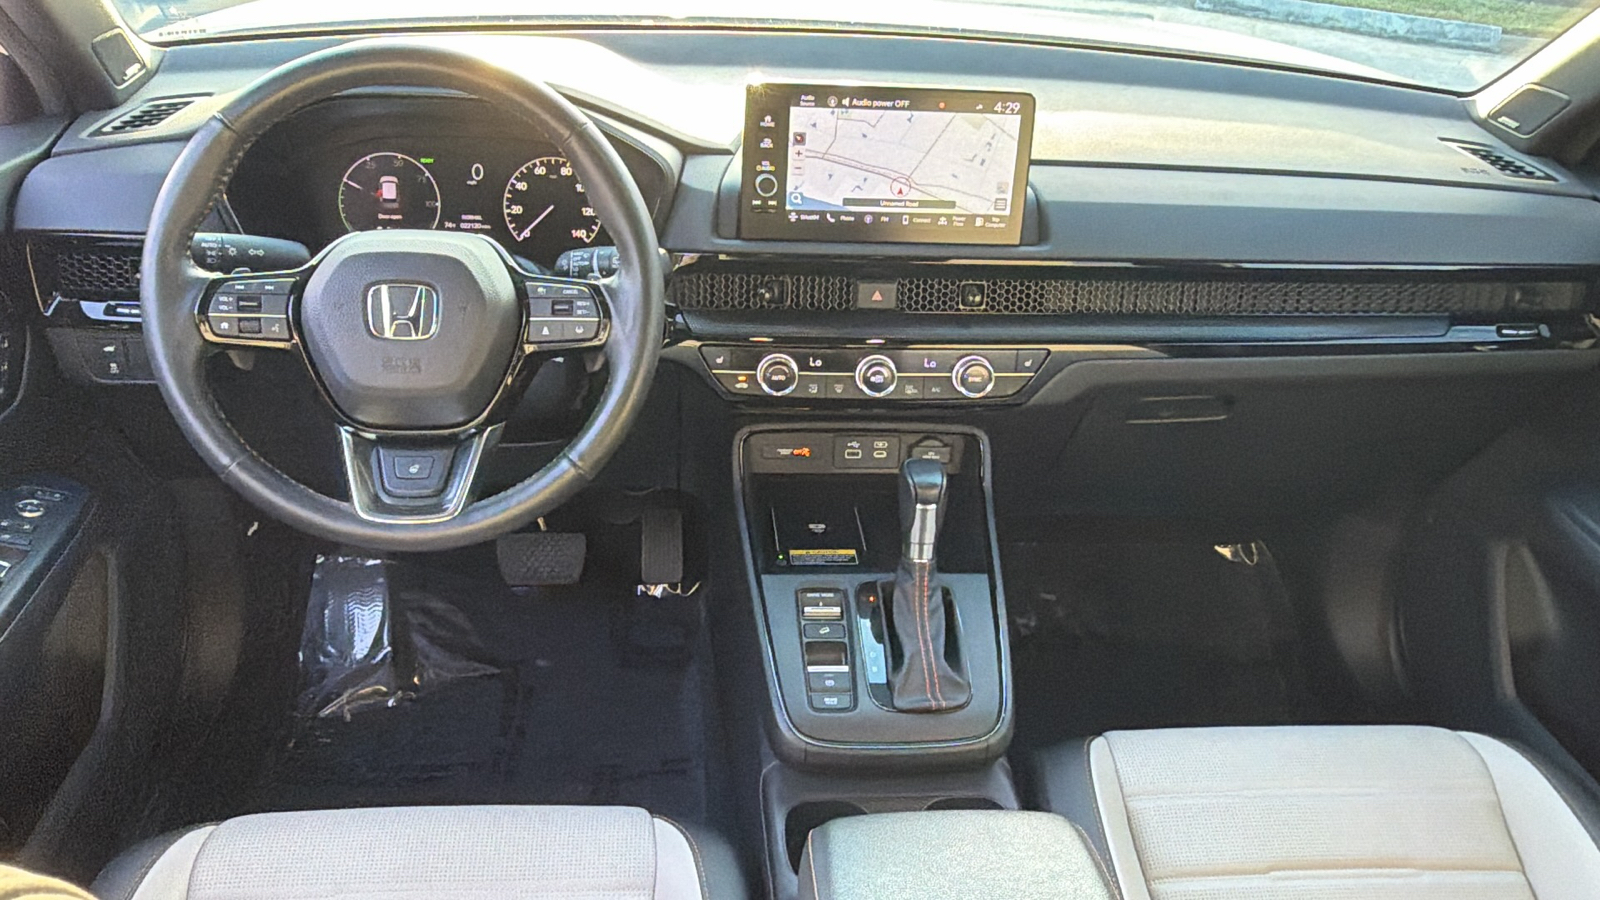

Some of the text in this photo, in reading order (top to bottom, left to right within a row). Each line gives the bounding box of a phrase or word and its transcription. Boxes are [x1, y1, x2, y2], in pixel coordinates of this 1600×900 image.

[851, 98, 911, 108] Audio power OFF
[993, 101, 1020, 114] 4:29
[534, 166, 546, 175] 60
[560, 167, 572, 176] 80
[515, 181, 528, 191] 40
[510, 205, 523, 214] 20
[571, 229, 586, 238] 140
[809, 357, 822, 367] Lo
[923, 358, 937, 368] Lo
